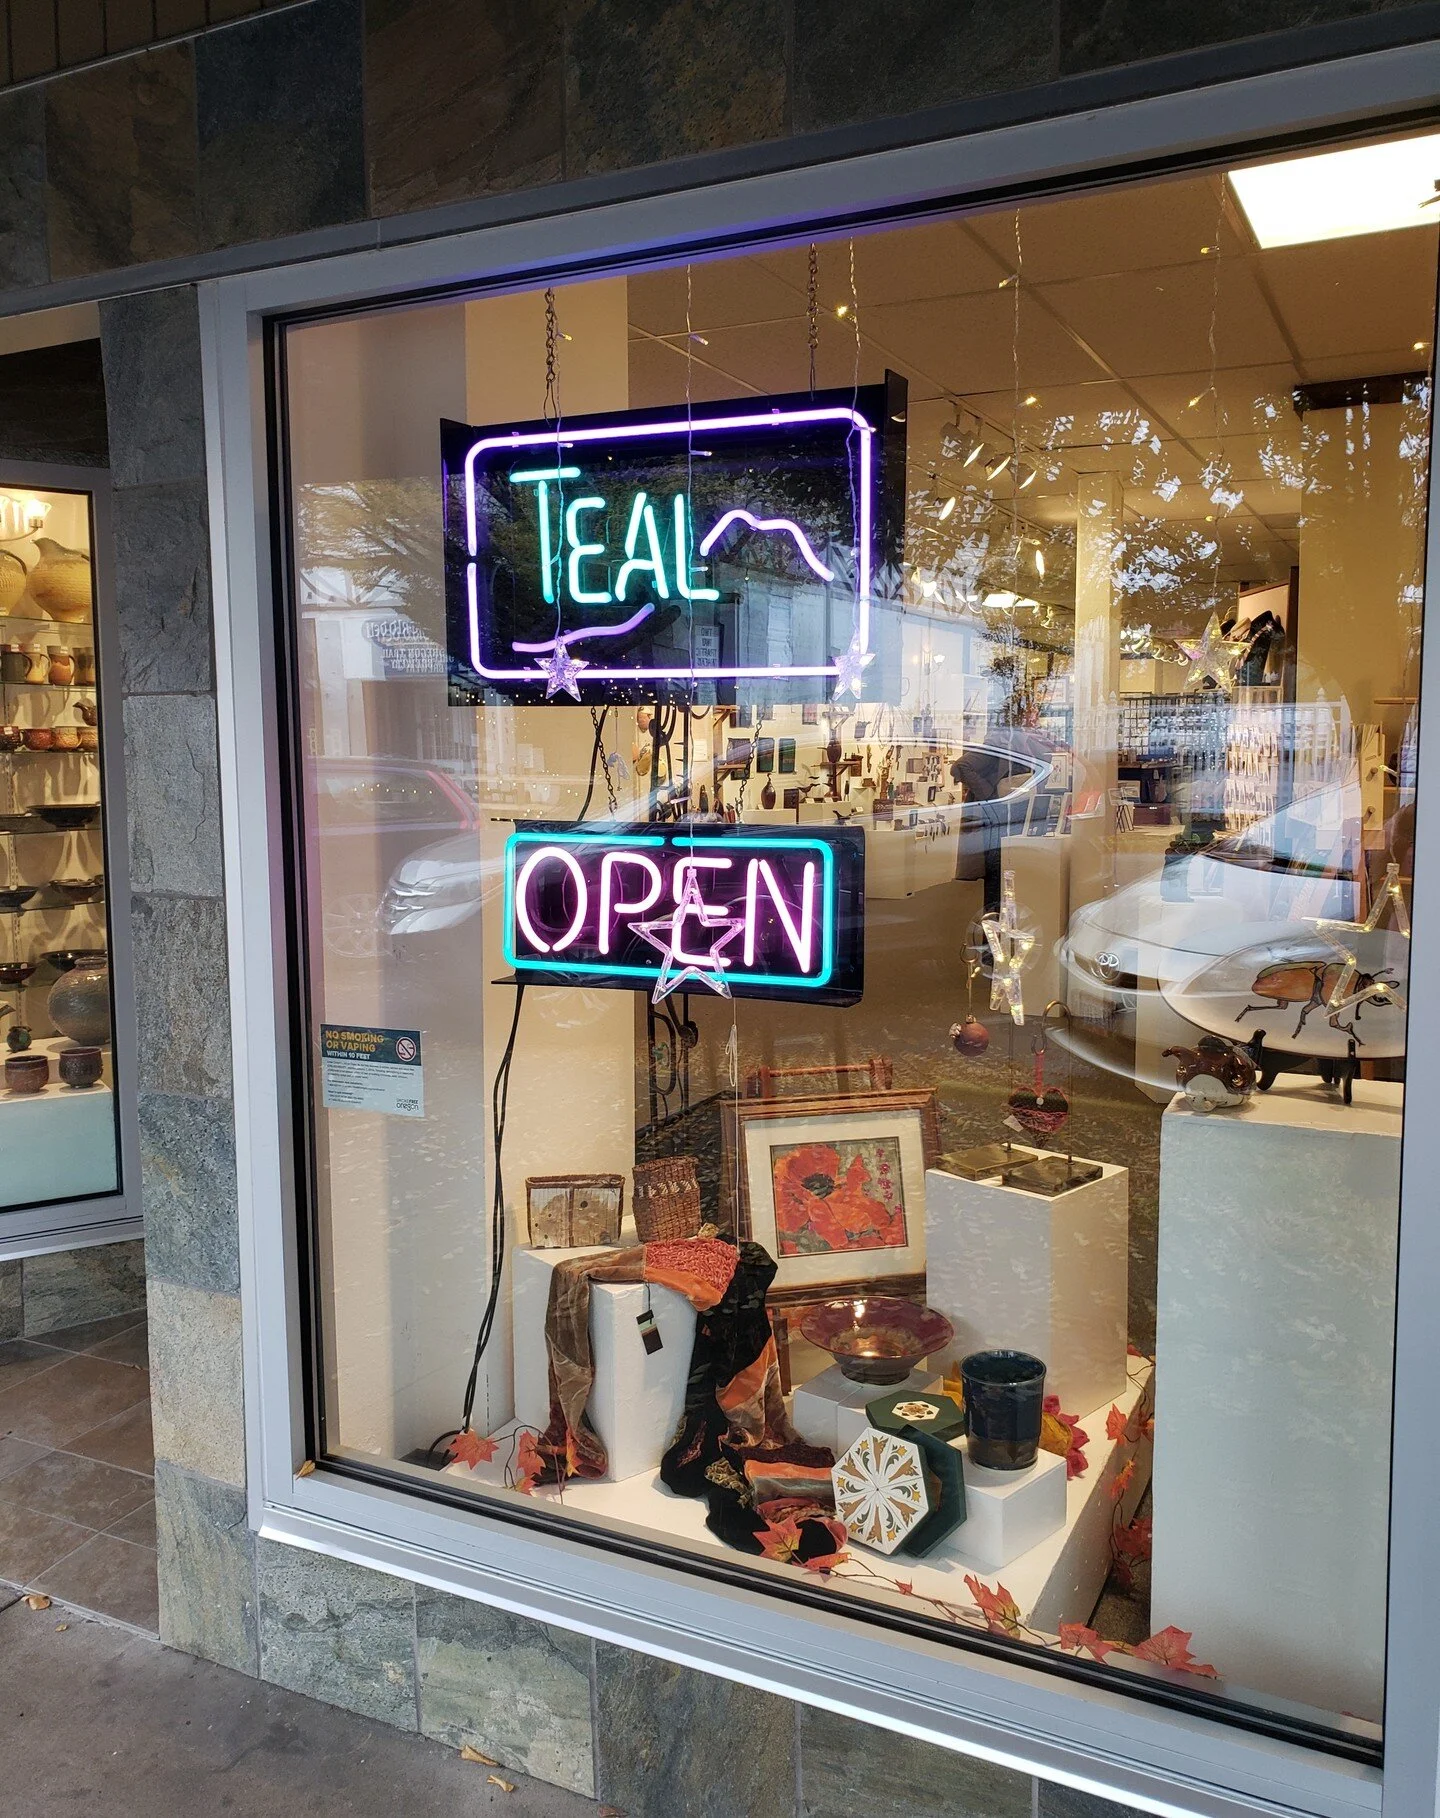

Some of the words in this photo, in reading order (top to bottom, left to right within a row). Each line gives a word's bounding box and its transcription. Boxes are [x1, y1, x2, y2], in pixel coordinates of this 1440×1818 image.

[509, 466, 720, 603] TEAL
[515, 846, 815, 973] OPEN
[325, 1030, 339, 1040] NO
[341, 1031, 384, 1043] SMOKING
[326, 1040, 339, 1049] OR
[341, 1041, 376, 1053] VAPING
[327, 1050, 348, 1058] WITHIN
[356, 1052, 371, 1060] FEET
